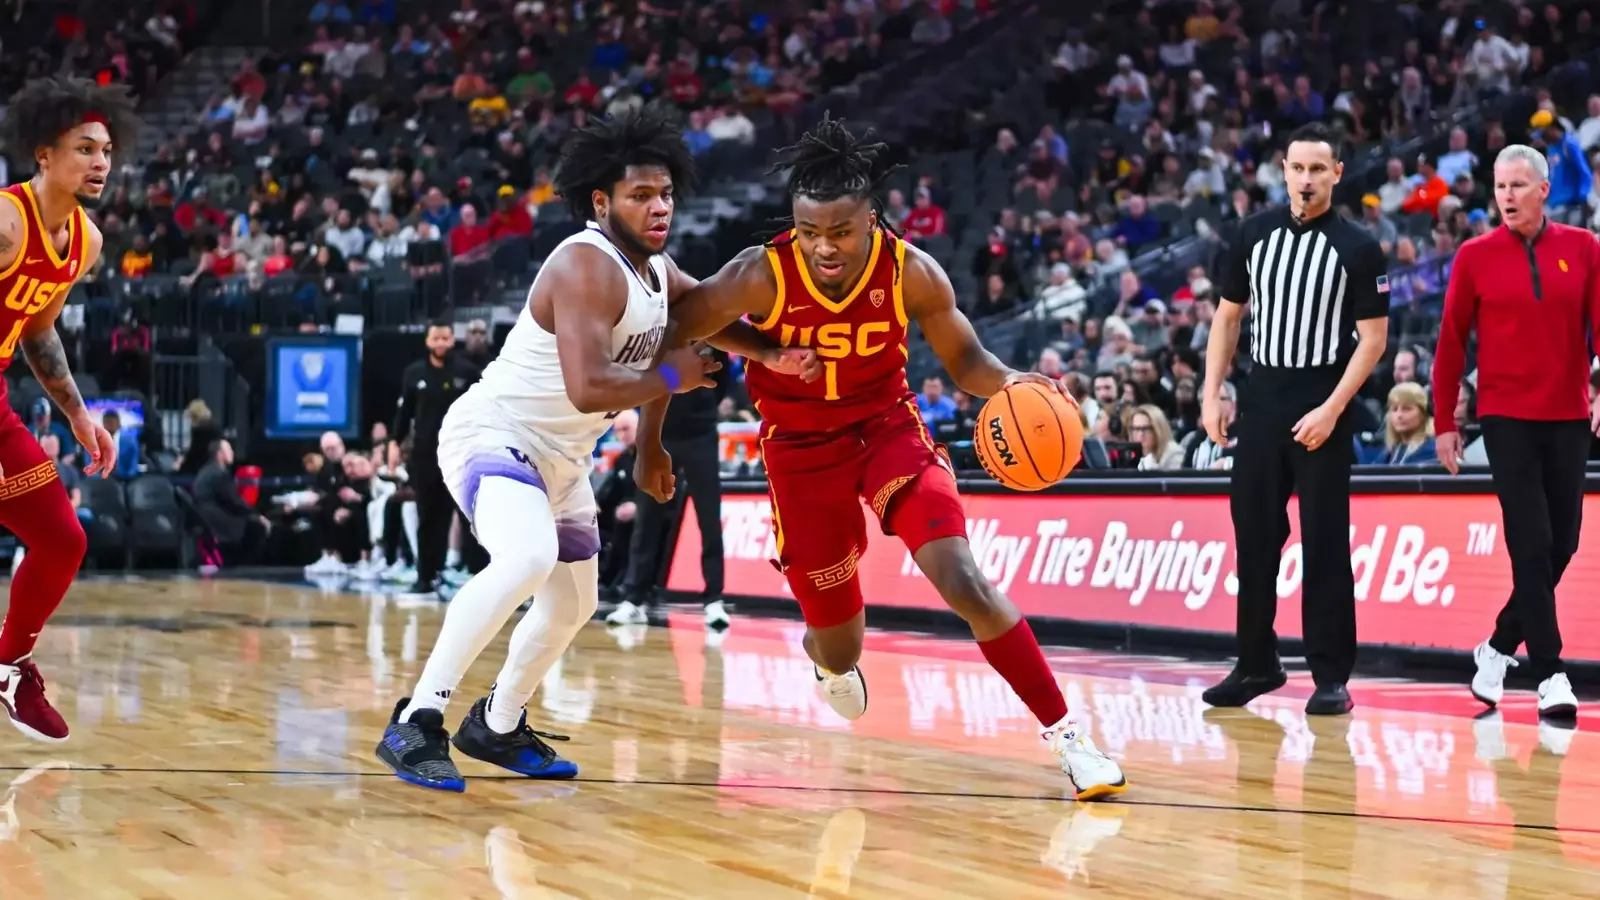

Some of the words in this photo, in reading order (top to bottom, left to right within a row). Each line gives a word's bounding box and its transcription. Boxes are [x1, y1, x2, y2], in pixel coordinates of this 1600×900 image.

[781, 321, 890, 358] USC
[824, 361, 840, 400] 1
[989, 416, 1019, 467] NCAA
[964, 518, 1032, 594] Way
[1027, 518, 1094, 587] Tire
[1089, 520, 1227, 611] Buying
[1379, 524, 1456, 608] Be.
